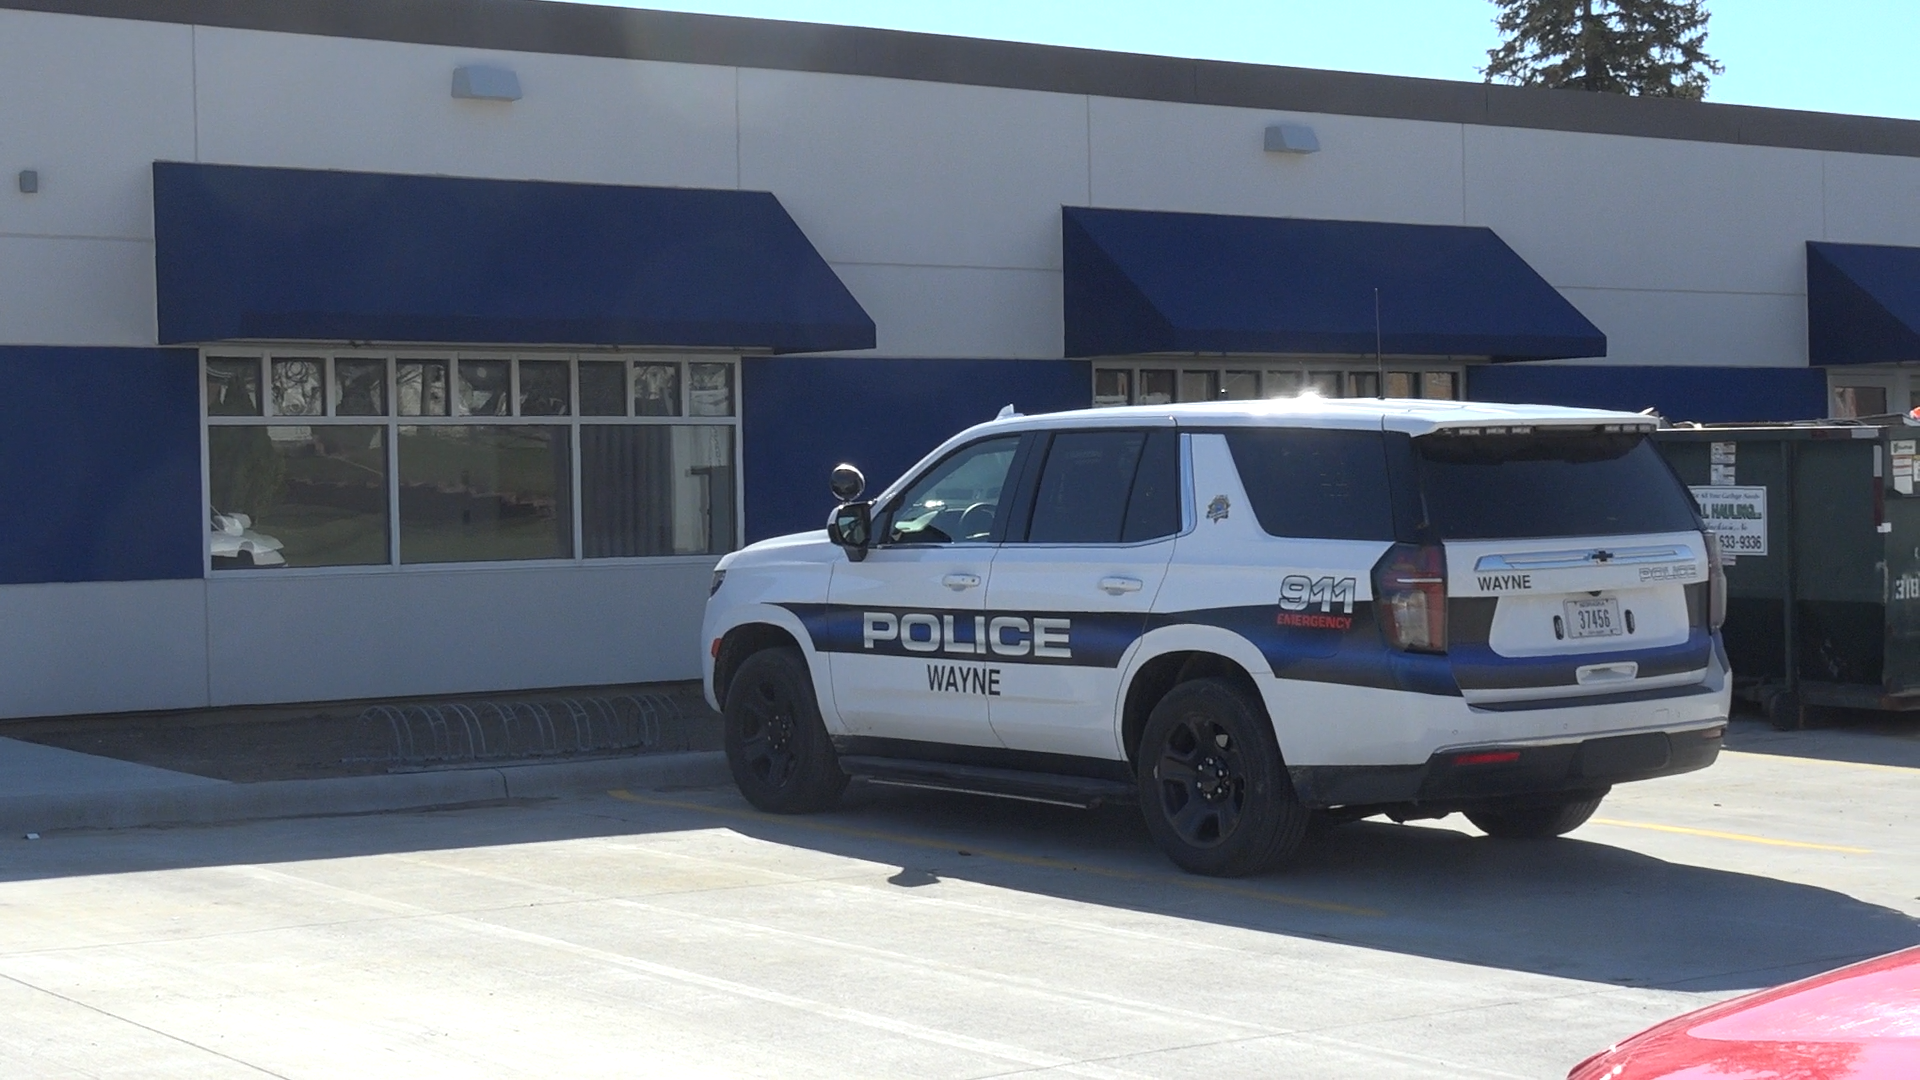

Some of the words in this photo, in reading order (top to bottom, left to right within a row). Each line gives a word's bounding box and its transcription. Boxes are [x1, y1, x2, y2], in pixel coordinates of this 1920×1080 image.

[1477, 574, 1532, 592] WAYNE
[1638, 564, 1697, 583] POLICE
[1278, 574, 1356, 614] 911
[1277, 613, 1352, 630] EMERGENCY
[1578, 609, 1611, 630] 37456
[863, 611, 1073, 658] POLICE
[927, 664, 1001, 696] WAYNE
